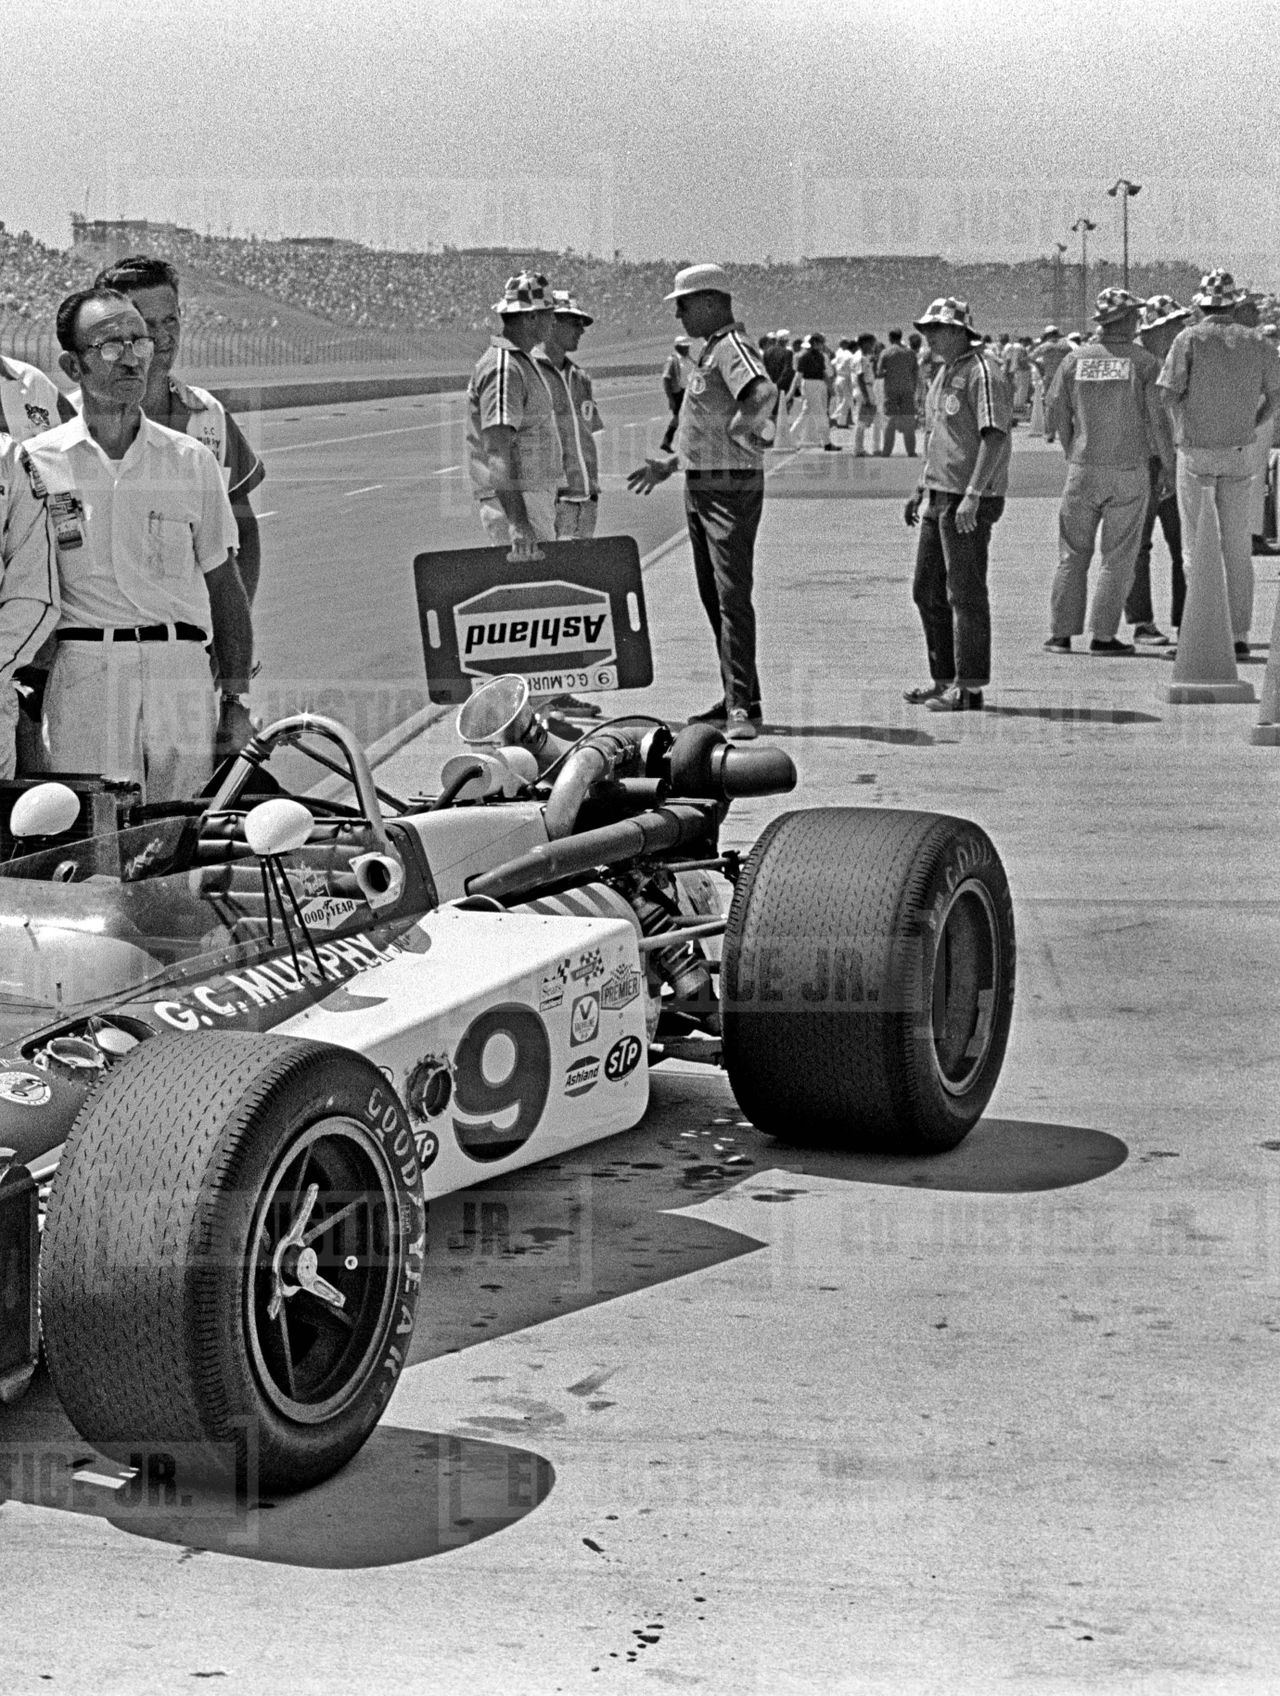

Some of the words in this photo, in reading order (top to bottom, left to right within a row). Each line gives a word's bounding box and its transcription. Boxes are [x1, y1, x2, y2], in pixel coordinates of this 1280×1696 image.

[464, 614, 607, 655] Ashland
[226, 933, 394, 1006] MURPHY
[608, 1038, 638, 1074] STP
[452, 1002, 551, 1163] 9
[565, 1064, 599, 1087] Ashland
[414, 1131, 435, 1163] TP
